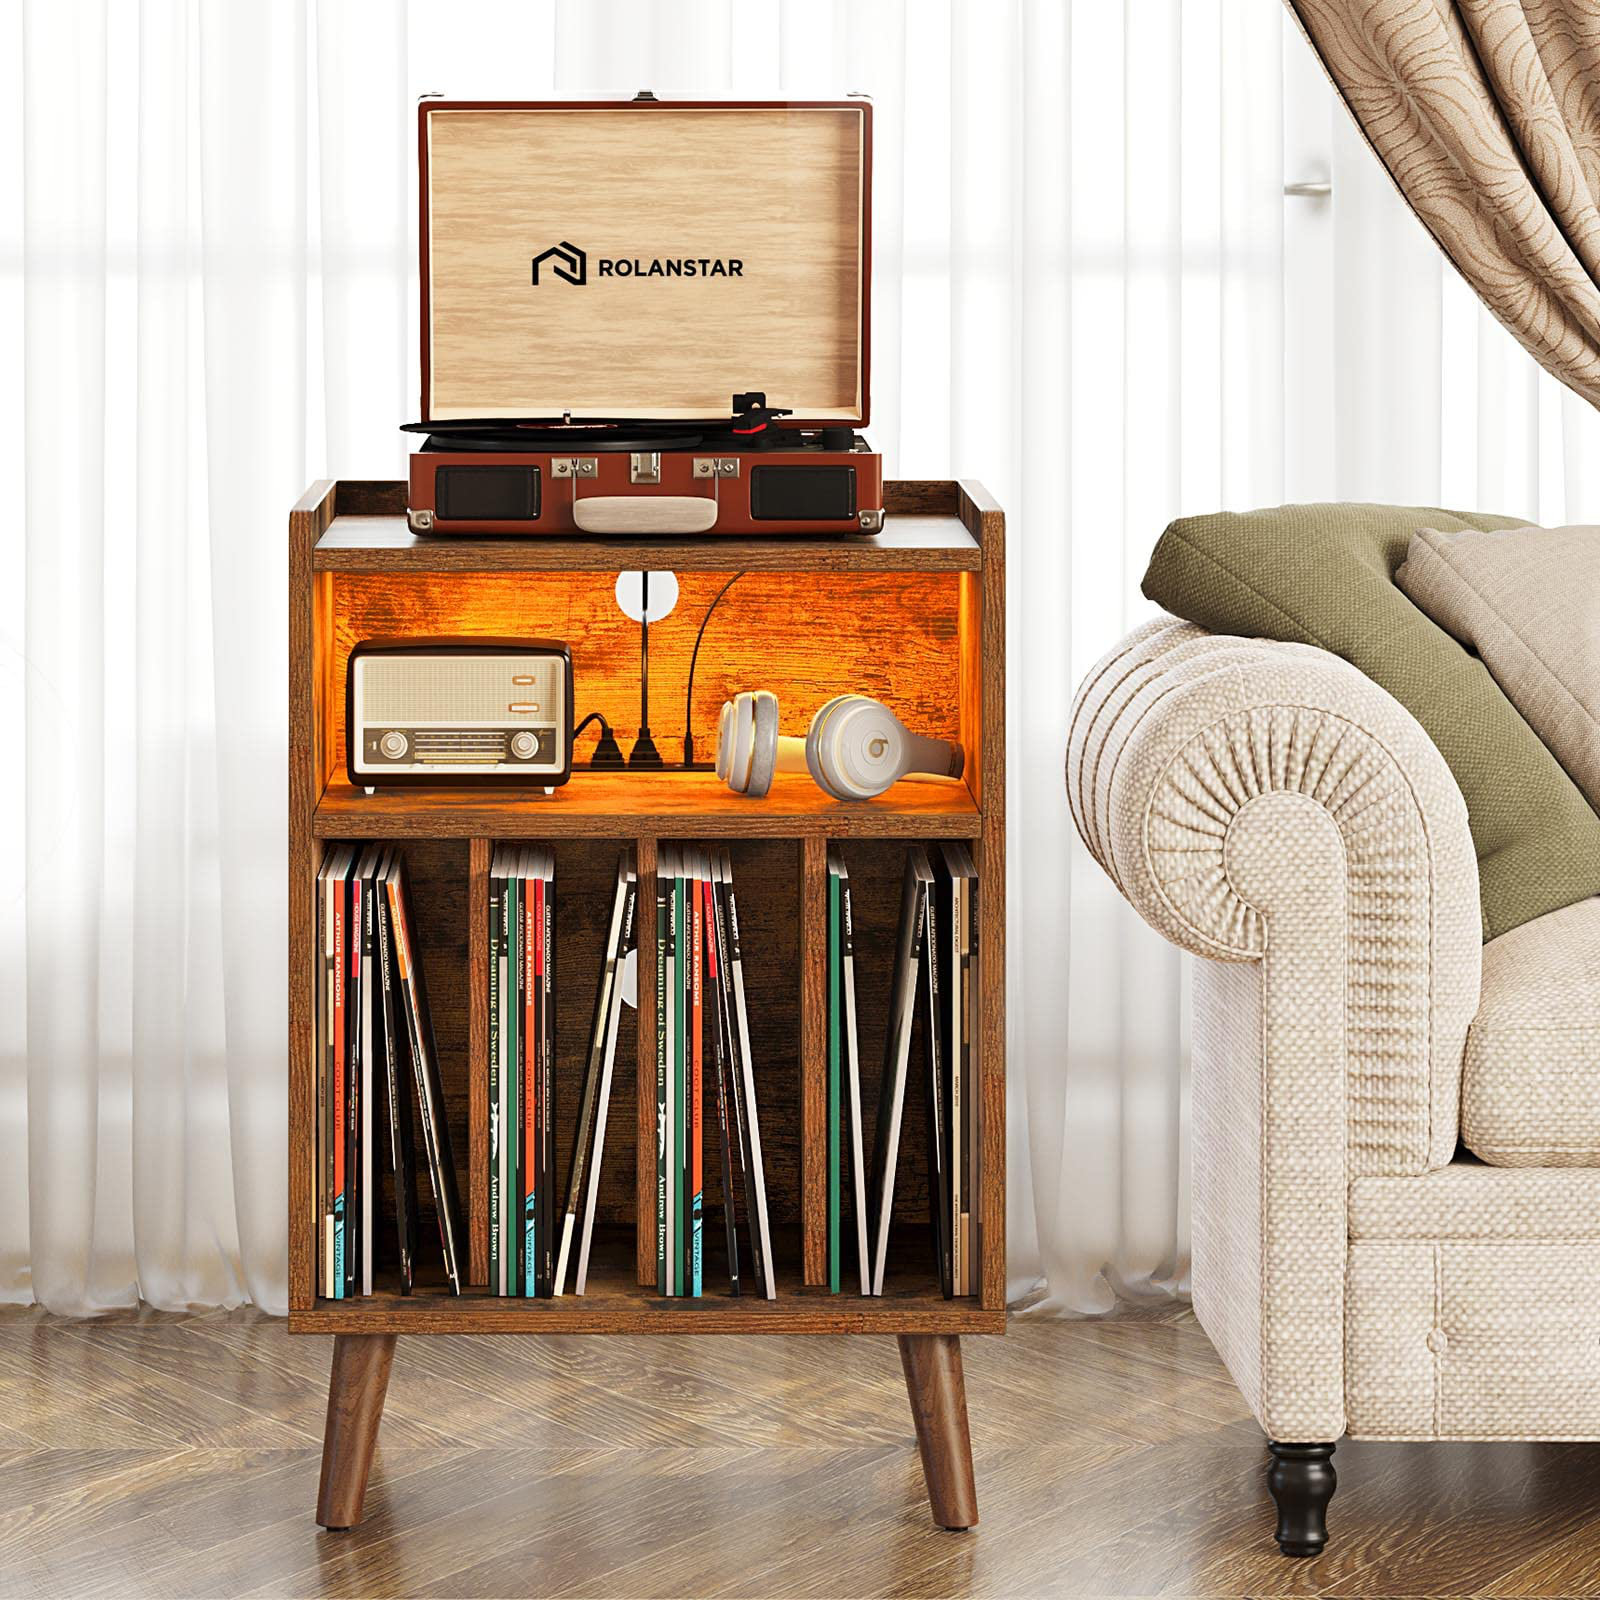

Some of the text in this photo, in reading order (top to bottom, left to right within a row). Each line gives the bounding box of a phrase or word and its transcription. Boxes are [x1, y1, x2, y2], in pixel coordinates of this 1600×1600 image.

[598, 258, 744, 277] ROLANSTAR
[490, 938, 499, 1087] Dreaming of Sweden
[657, 938, 666, 1087] Dreaming of Sweden
[491, 1174, 499, 1261] Andrew Brown
[658, 1174, 666, 1261] Andrew Brown
